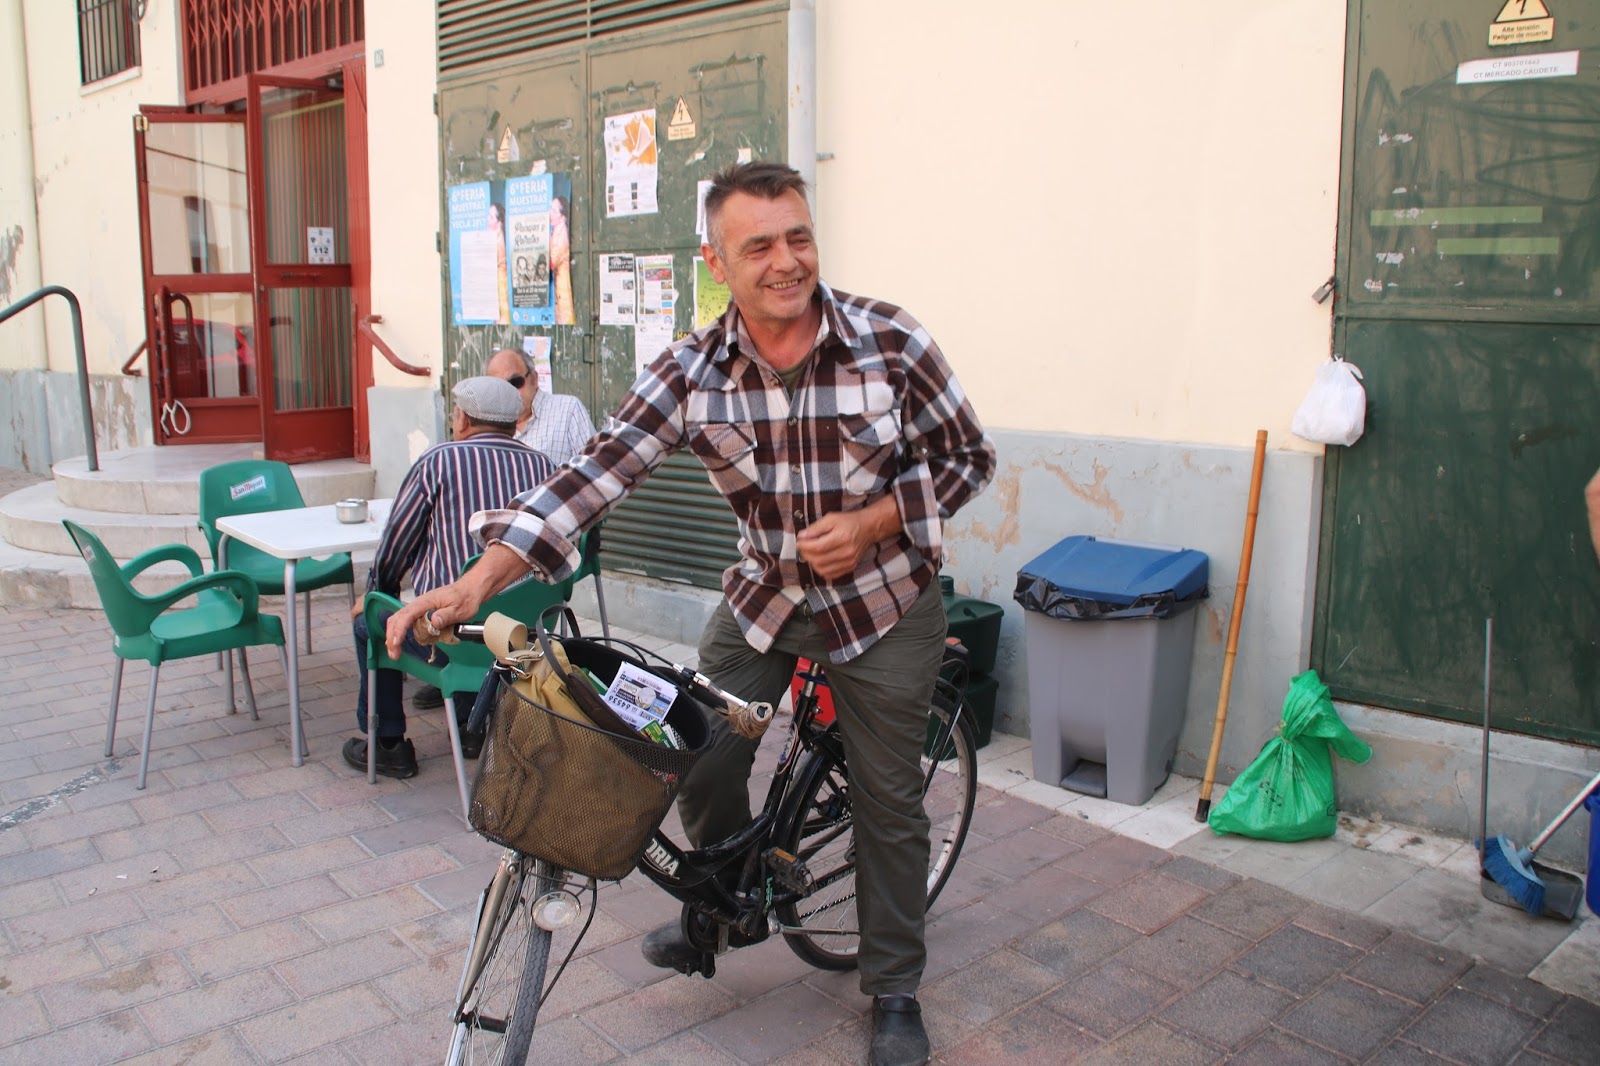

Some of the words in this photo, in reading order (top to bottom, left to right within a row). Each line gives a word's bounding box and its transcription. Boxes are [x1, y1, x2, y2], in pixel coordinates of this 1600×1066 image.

[1492, 33, 1515, 41] Peligro
[1484, 69, 1522, 78] MERCADO
[1523, 66, 1559, 75] CAUDETE
[519, 181, 547, 194] FERIA
[460, 188, 485, 200] FERIA
[510, 194, 547, 206] MUESTRAS
[452, 201, 485, 211] MUESTRAS
[313, 246, 329, 254] 112
